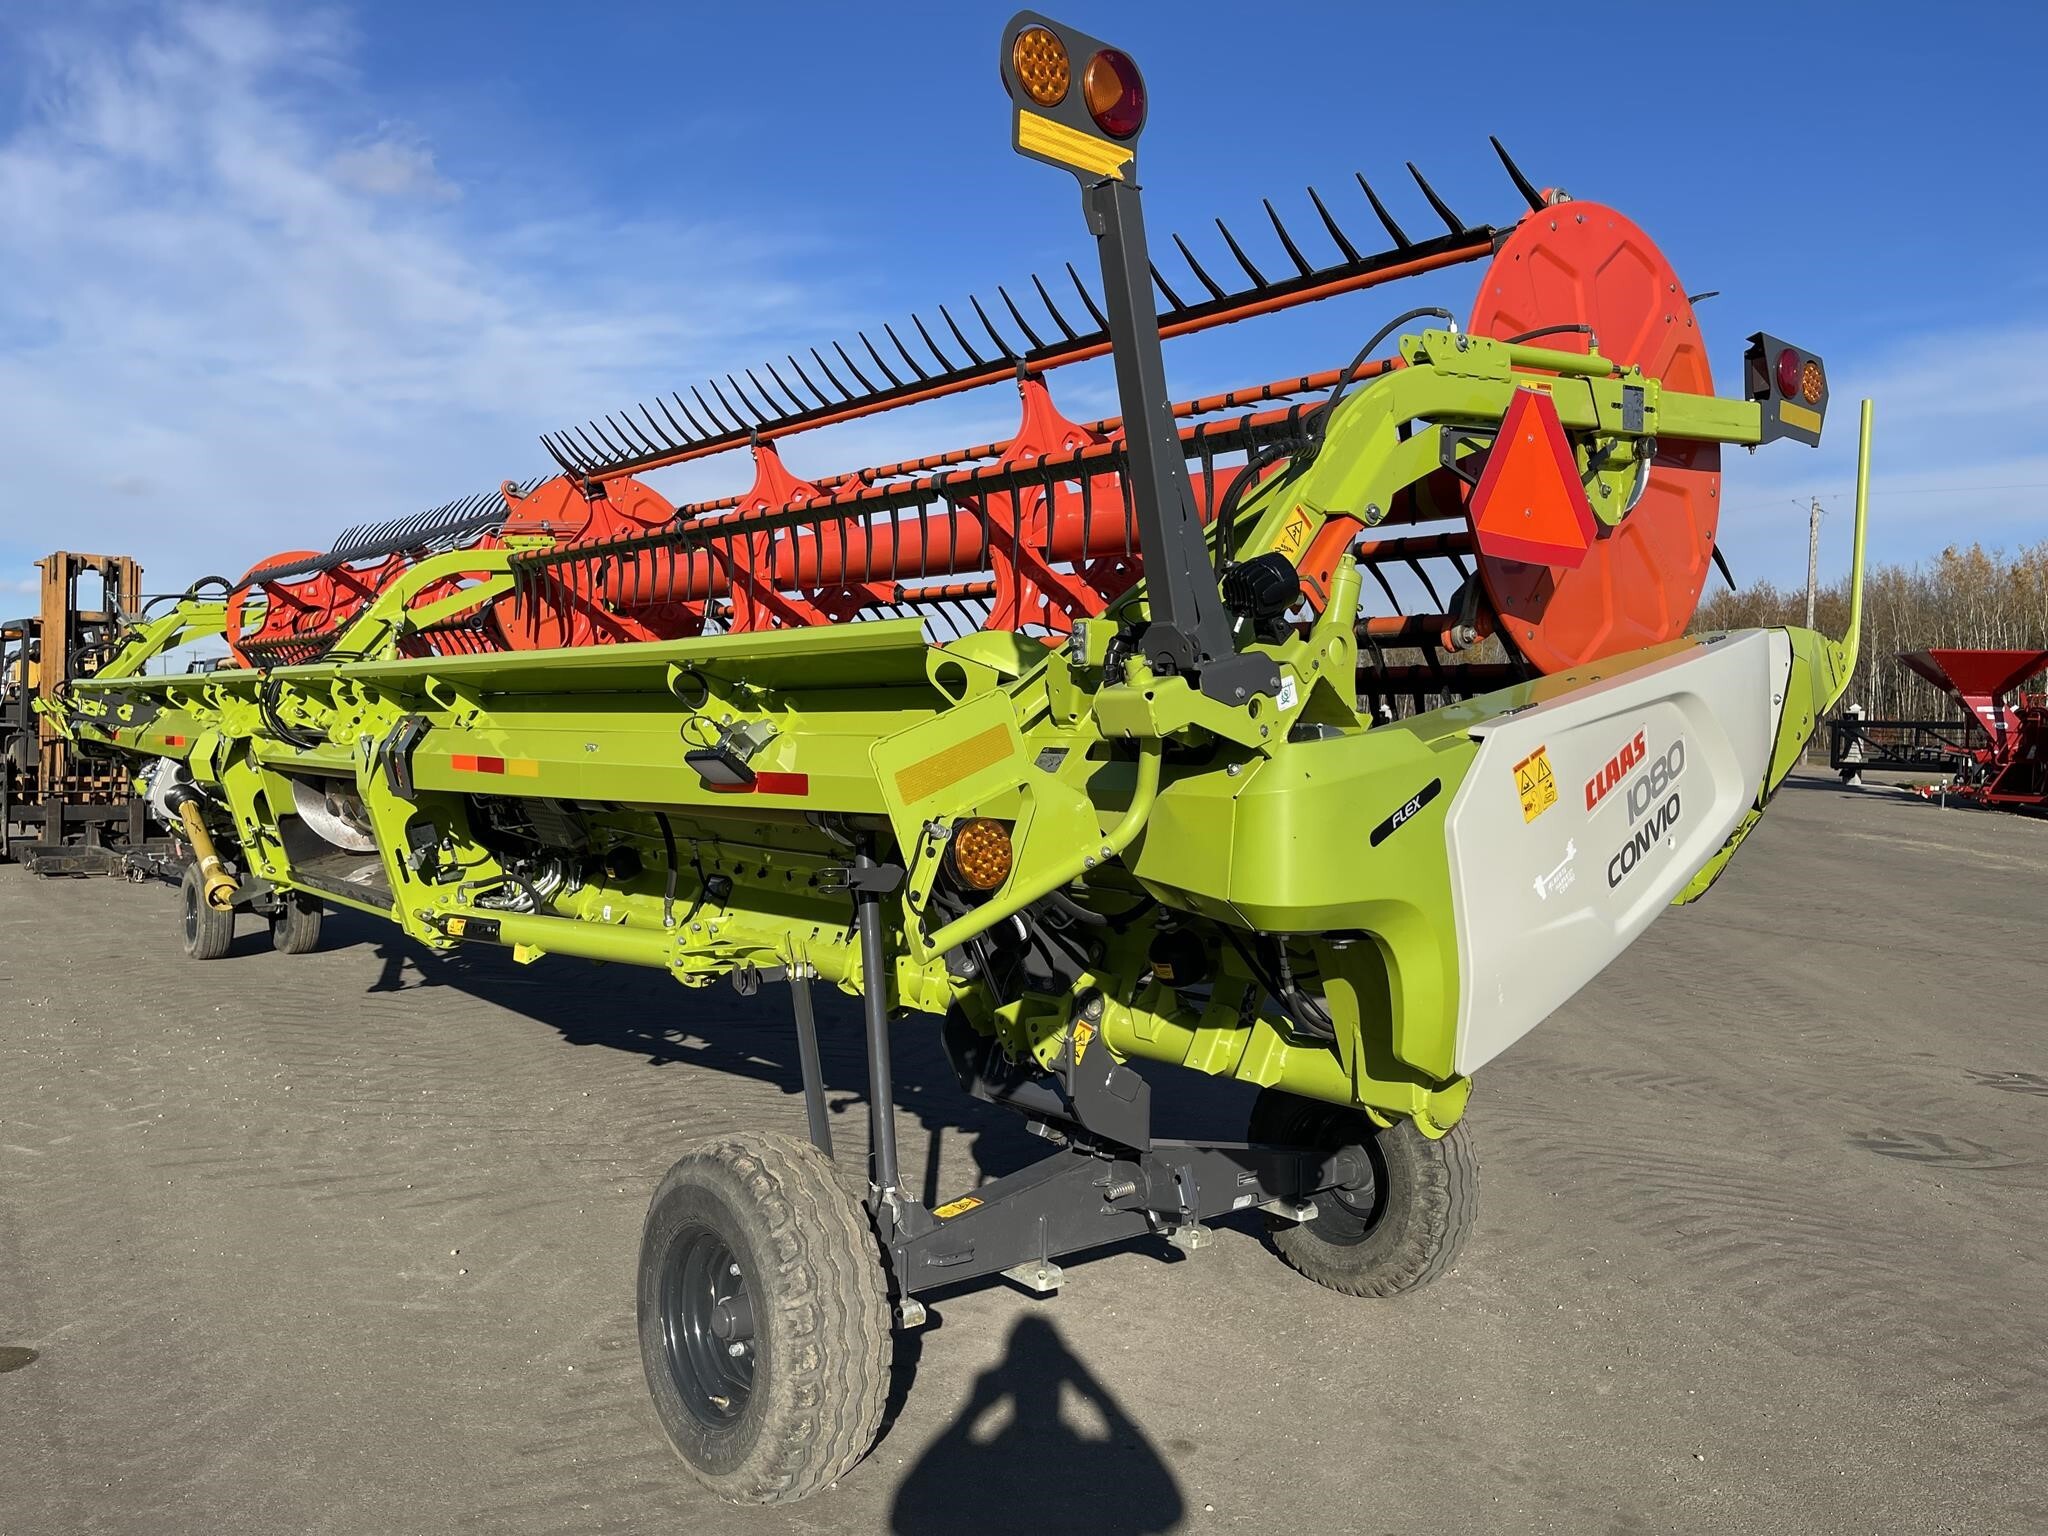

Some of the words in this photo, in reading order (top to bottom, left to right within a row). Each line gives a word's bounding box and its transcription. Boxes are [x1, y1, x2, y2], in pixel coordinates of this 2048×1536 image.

[1392, 795, 1422, 829] FLEX
[1585, 730, 1646, 812] CLAAS
[1626, 739, 1685, 826] 1080
[1607, 792, 1681, 889] CONVIO
